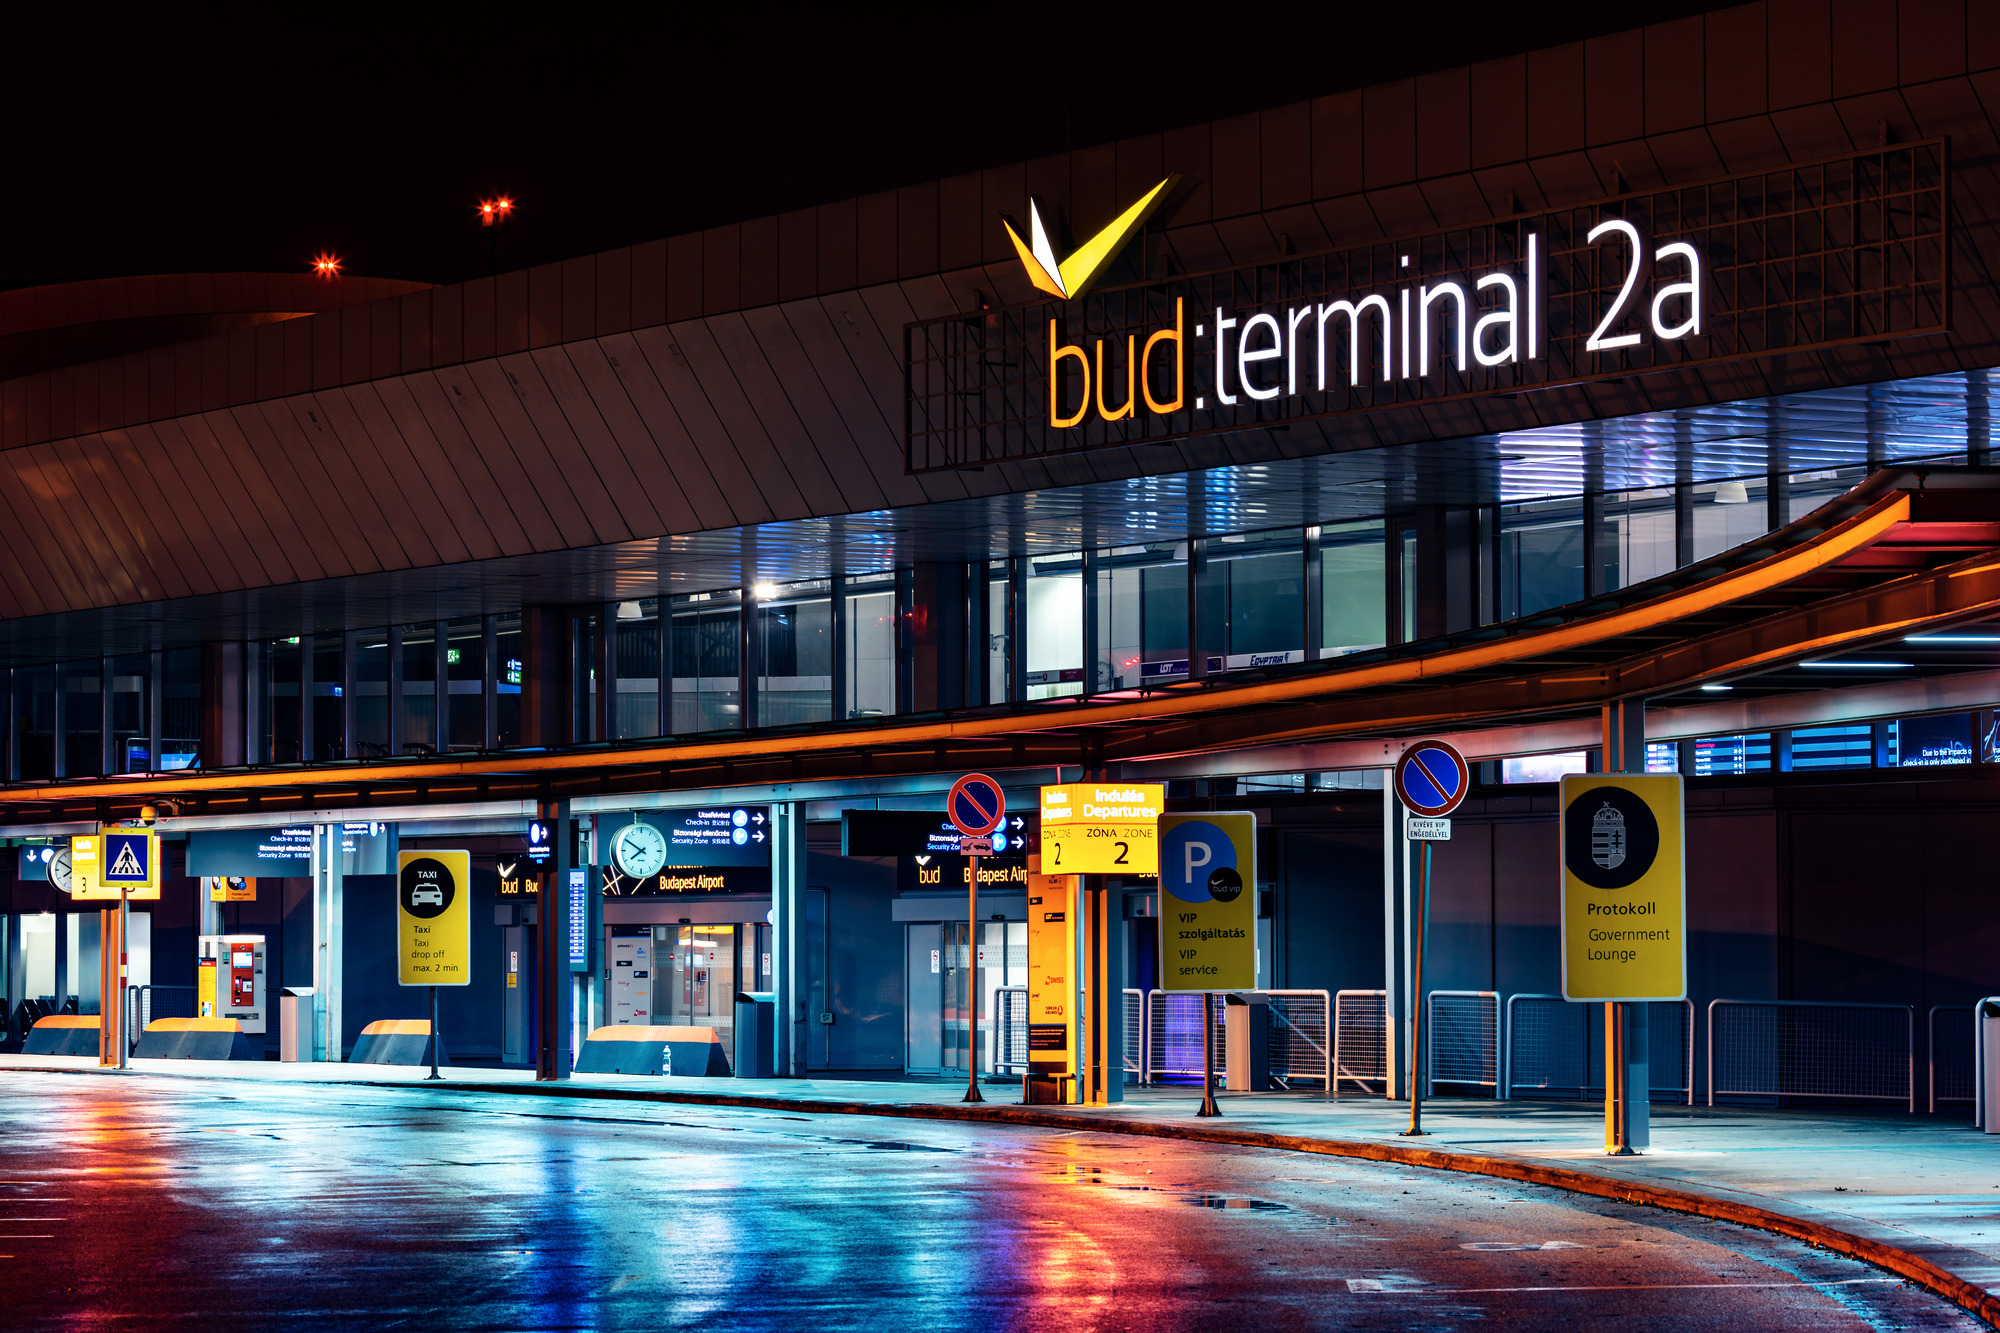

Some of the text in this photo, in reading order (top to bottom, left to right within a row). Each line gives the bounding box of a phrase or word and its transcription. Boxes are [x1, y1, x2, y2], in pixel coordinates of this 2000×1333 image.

[1585, 219, 1702, 352] 2a
[1160, 663, 1173, 673] LOT
[1922, 749, 1933, 757] Due
[1095, 789, 1145, 802] Indulás
[1083, 804, 1157, 820] Departures
[1413, 820, 1433, 828] KIVÉVE
[1086, 827, 1153, 838] ZÓNA ZONE
[671, 837, 693, 845] Security
[927, 843, 950, 851] Security
[1114, 841, 1129, 864] 2
[1054, 842, 1061, 865] 2
[1185, 841, 1212, 883] P
[417, 870, 437, 879] TAXI
[919, 865, 940, 883] bud
[963, 866, 1009, 886] Bdapest
[81, 876, 87, 893] 3
[501, 877, 519, 894] bud
[659, 874, 724, 892] Budapest Airport
[1212, 885, 1228, 893] bud
[1587, 901, 1656, 915] Protokoll
[1178, 913, 1198, 924] VIP
[413, 925, 431, 934] Taxi
[1178, 928, 1246, 941] szolgáltatás
[1588, 928, 1671, 942] Government
[413, 938, 429, 947] Taxi
[411, 949, 446, 960] drop off
[1179, 949, 1197, 960] VIP
[1587, 947, 1636, 963] Lounge
[412, 963, 459, 972] max. 2 min
[1179, 965, 1219, 975] service
[1050, 976, 1065, 984] SWISS
